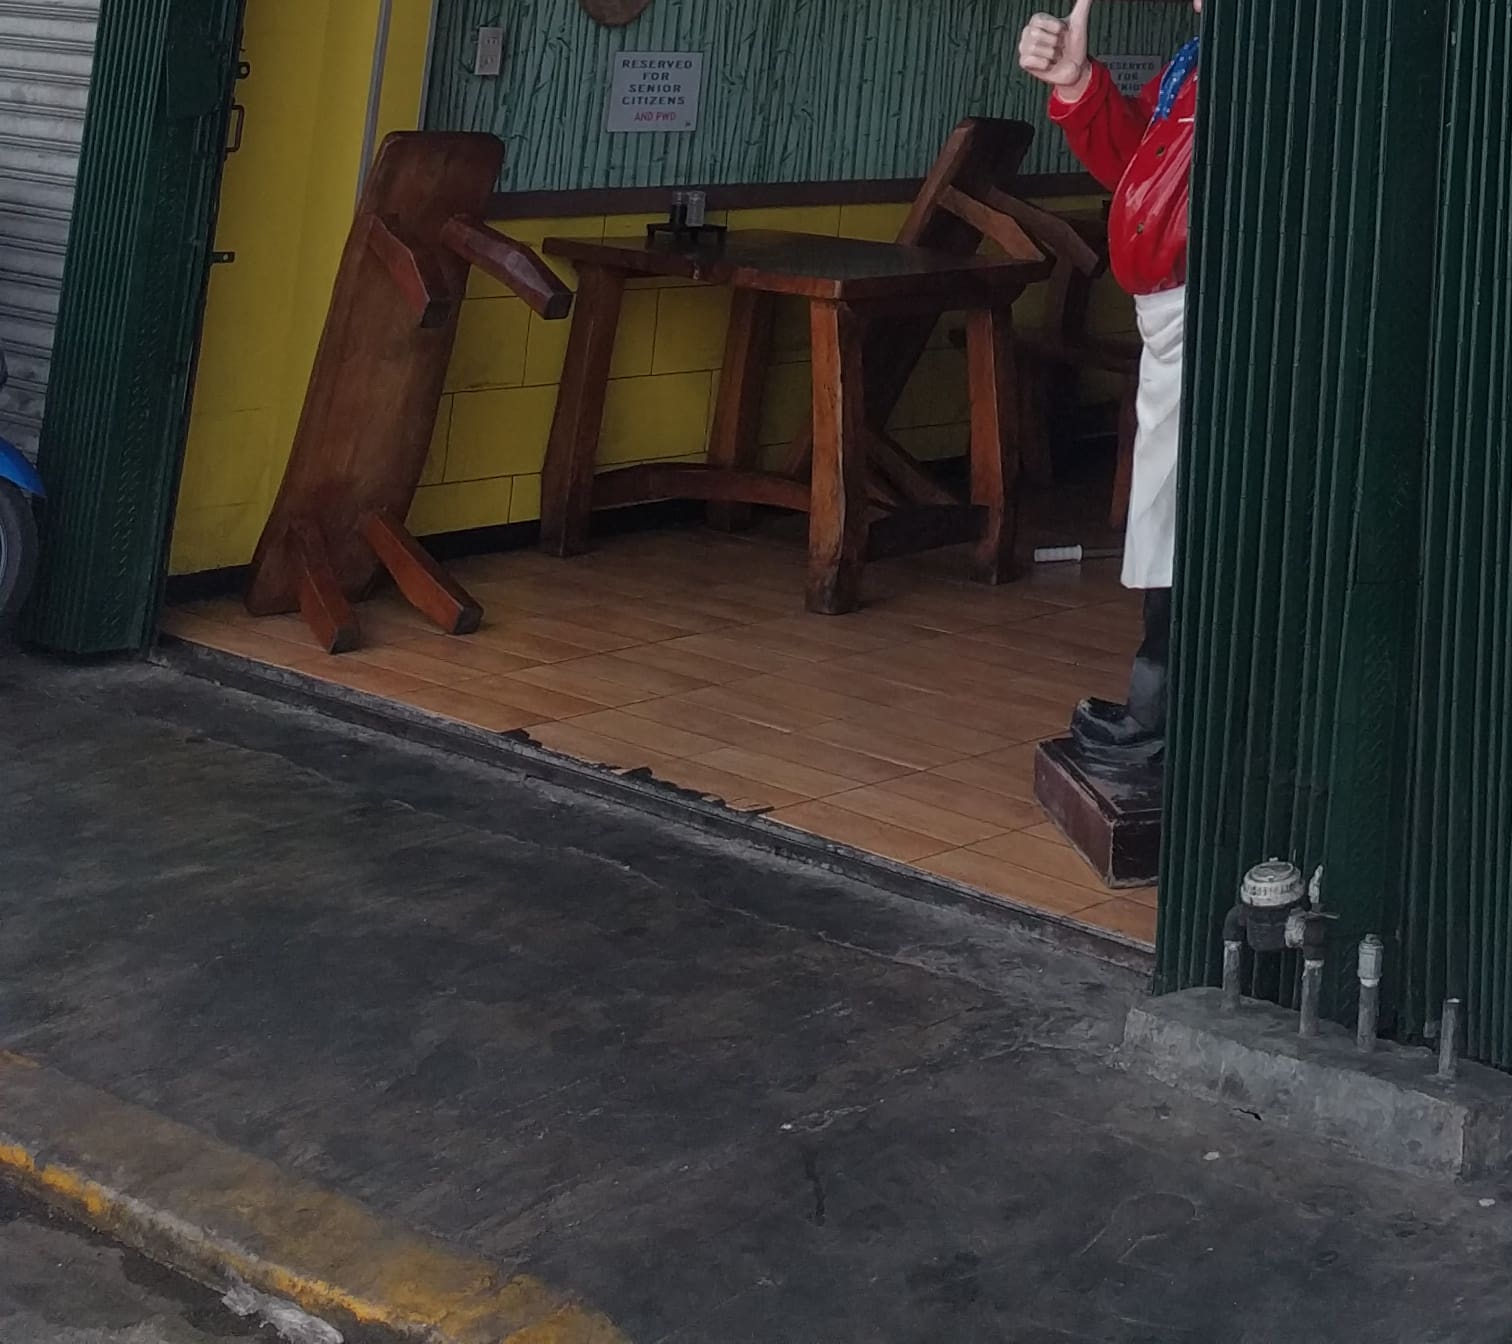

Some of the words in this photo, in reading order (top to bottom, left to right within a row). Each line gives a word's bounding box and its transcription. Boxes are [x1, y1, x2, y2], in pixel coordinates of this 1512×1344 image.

[622, 59, 693, 69] RESERVED
[642, 72, 670, 81] FOR
[628, 84, 682, 93] SENIOR
[622, 96, 685, 105] CITIZENS
[634, 111, 653, 121] AND
